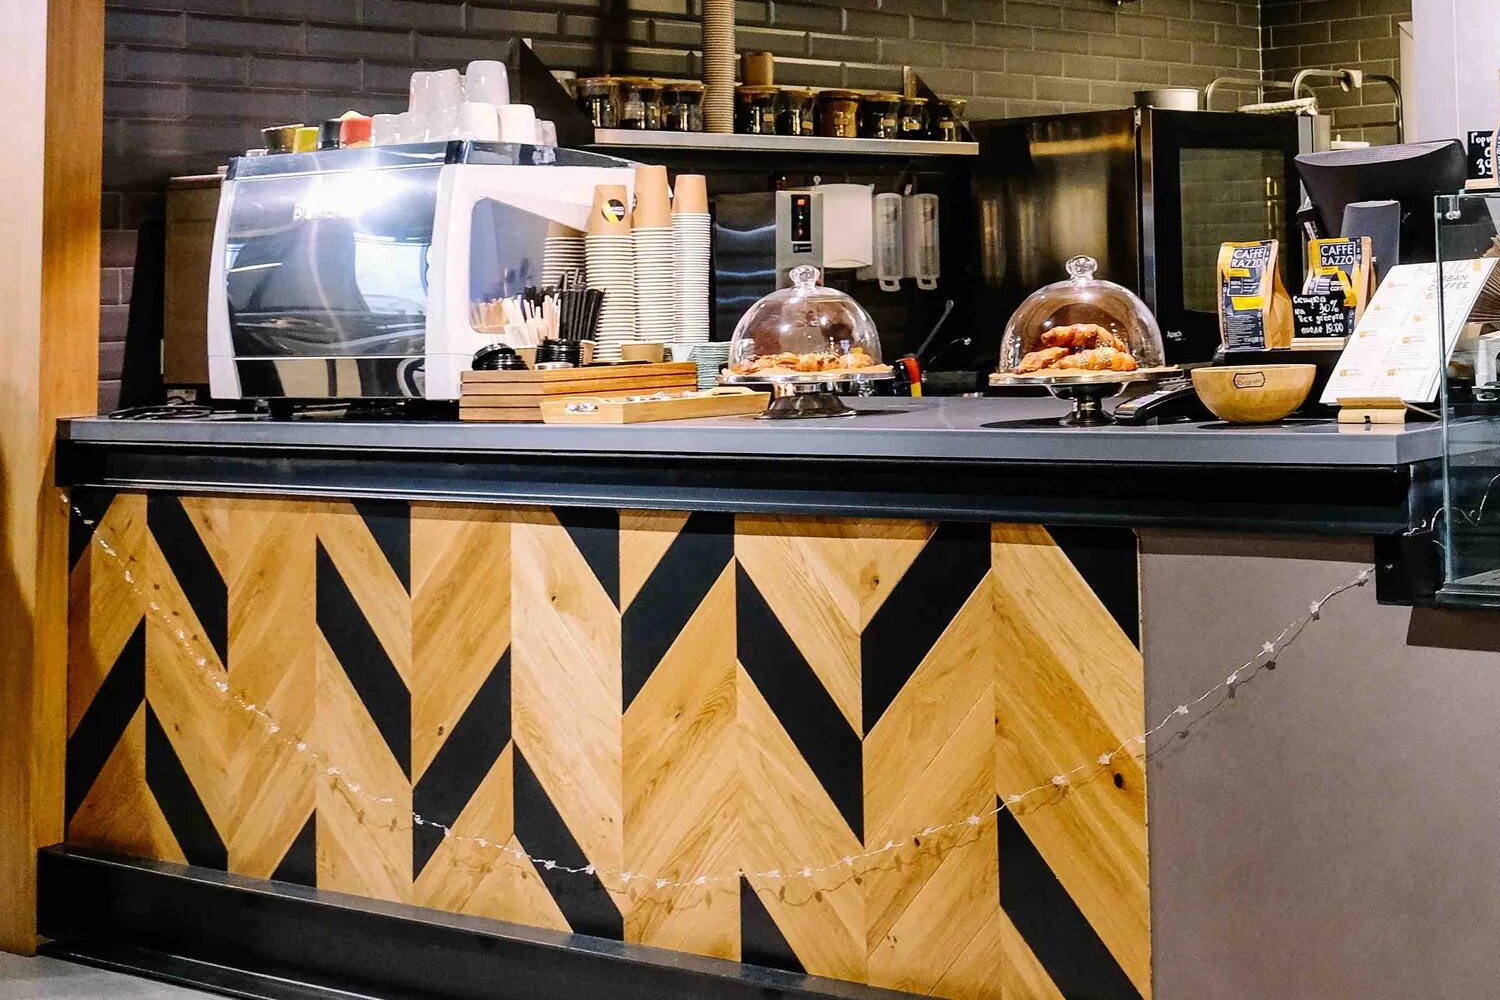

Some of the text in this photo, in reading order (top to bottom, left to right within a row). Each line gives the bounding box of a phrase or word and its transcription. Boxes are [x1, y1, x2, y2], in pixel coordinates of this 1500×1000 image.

[1233, 249, 1264, 259] CAFFE
[1321, 244, 1354, 257] CAFFE
[1321, 255, 1354, 266] RAZZO
[1319, 299, 1339, 313] 30%
